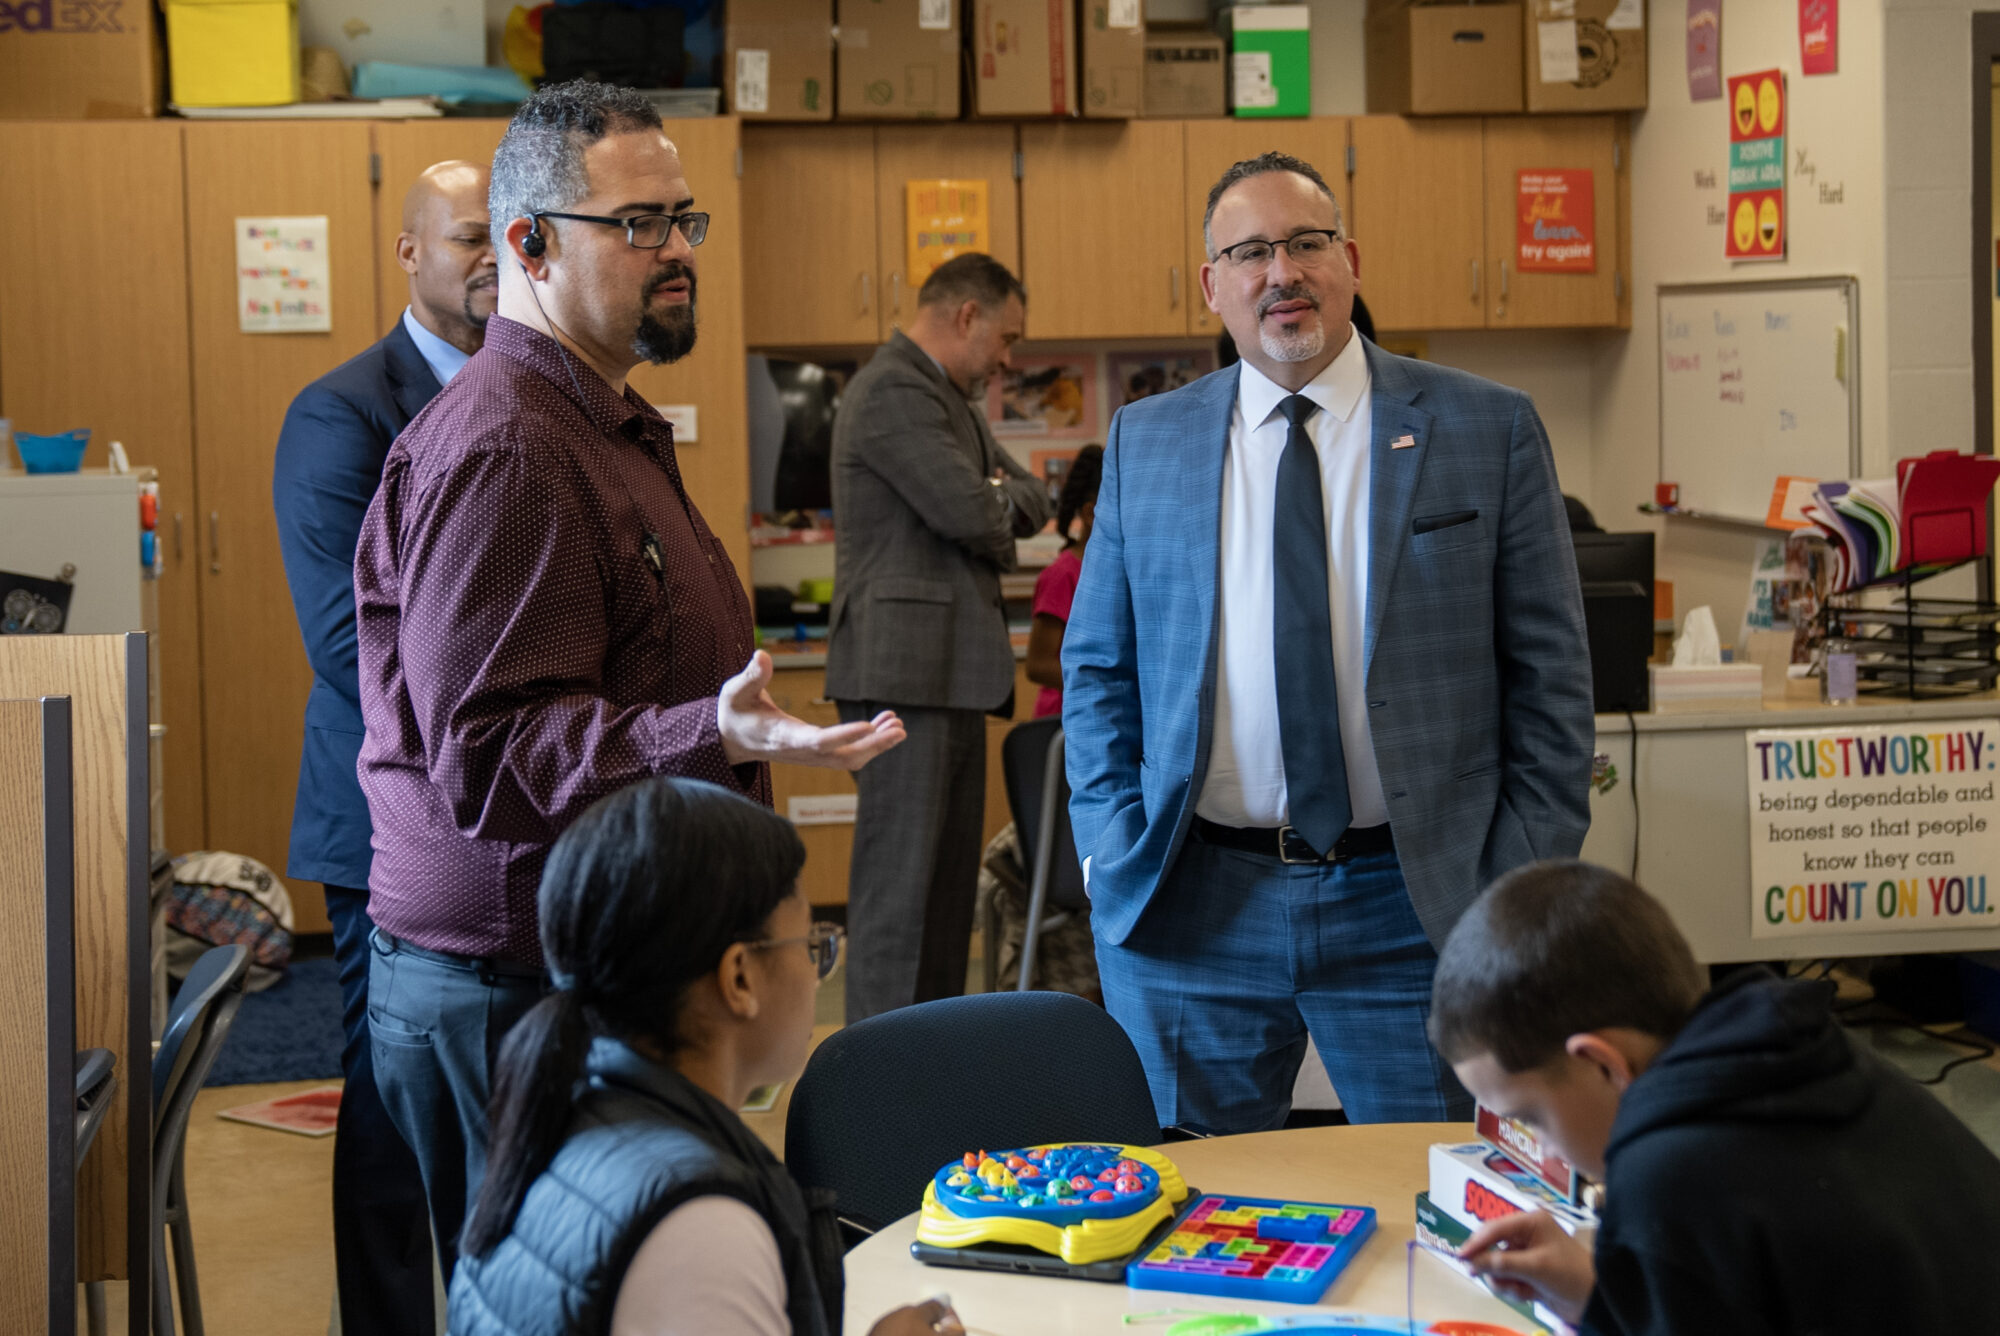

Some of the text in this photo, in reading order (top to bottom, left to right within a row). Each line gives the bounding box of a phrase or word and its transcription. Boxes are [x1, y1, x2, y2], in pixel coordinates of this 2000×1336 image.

[1819, 182, 1844, 204] Hard
[1707, 205, 1725, 225] Har
[1755, 731, 1996, 781] TRUSTWORTHY:
[1759, 781, 1994, 812] being dependable and
[1769, 814, 1988, 842] honest so that people
[1803, 848, 1955, 871] know they can
[1765, 875, 1995, 925] COUNT ON YOU.
